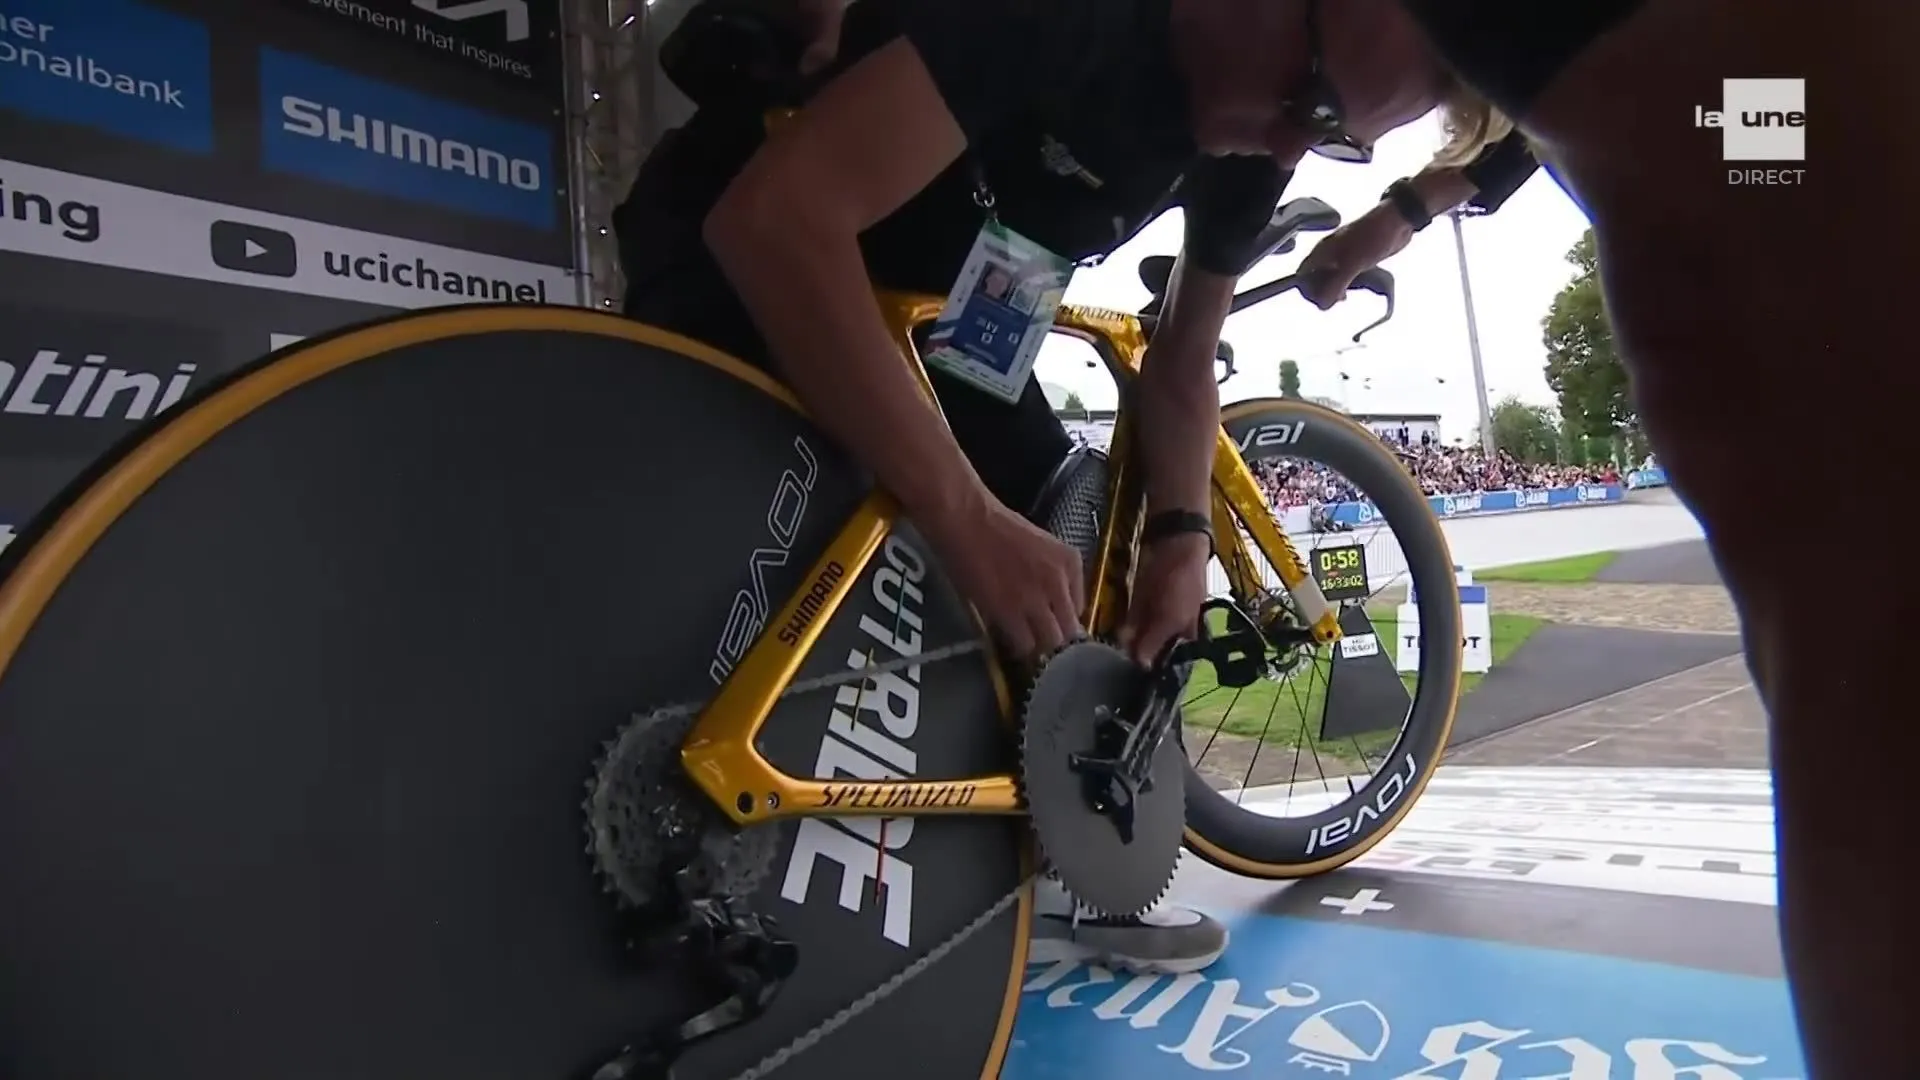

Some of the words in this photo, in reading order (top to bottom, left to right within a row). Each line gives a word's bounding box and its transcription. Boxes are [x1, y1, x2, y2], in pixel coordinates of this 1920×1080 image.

[414, 23, 454, 51] that
[461, 41, 532, 79] inspires
[281, 96, 540, 191] SHIMANO
[323, 248, 547, 304] ucichannel
[710, 436, 818, 685] roval
[1320, 551, 1359, 571] 0:58
[777, 560, 845, 647] SHIMANO
[820, 783, 977, 808] SPECIALIZED
[1305, 753, 1416, 855] roval
